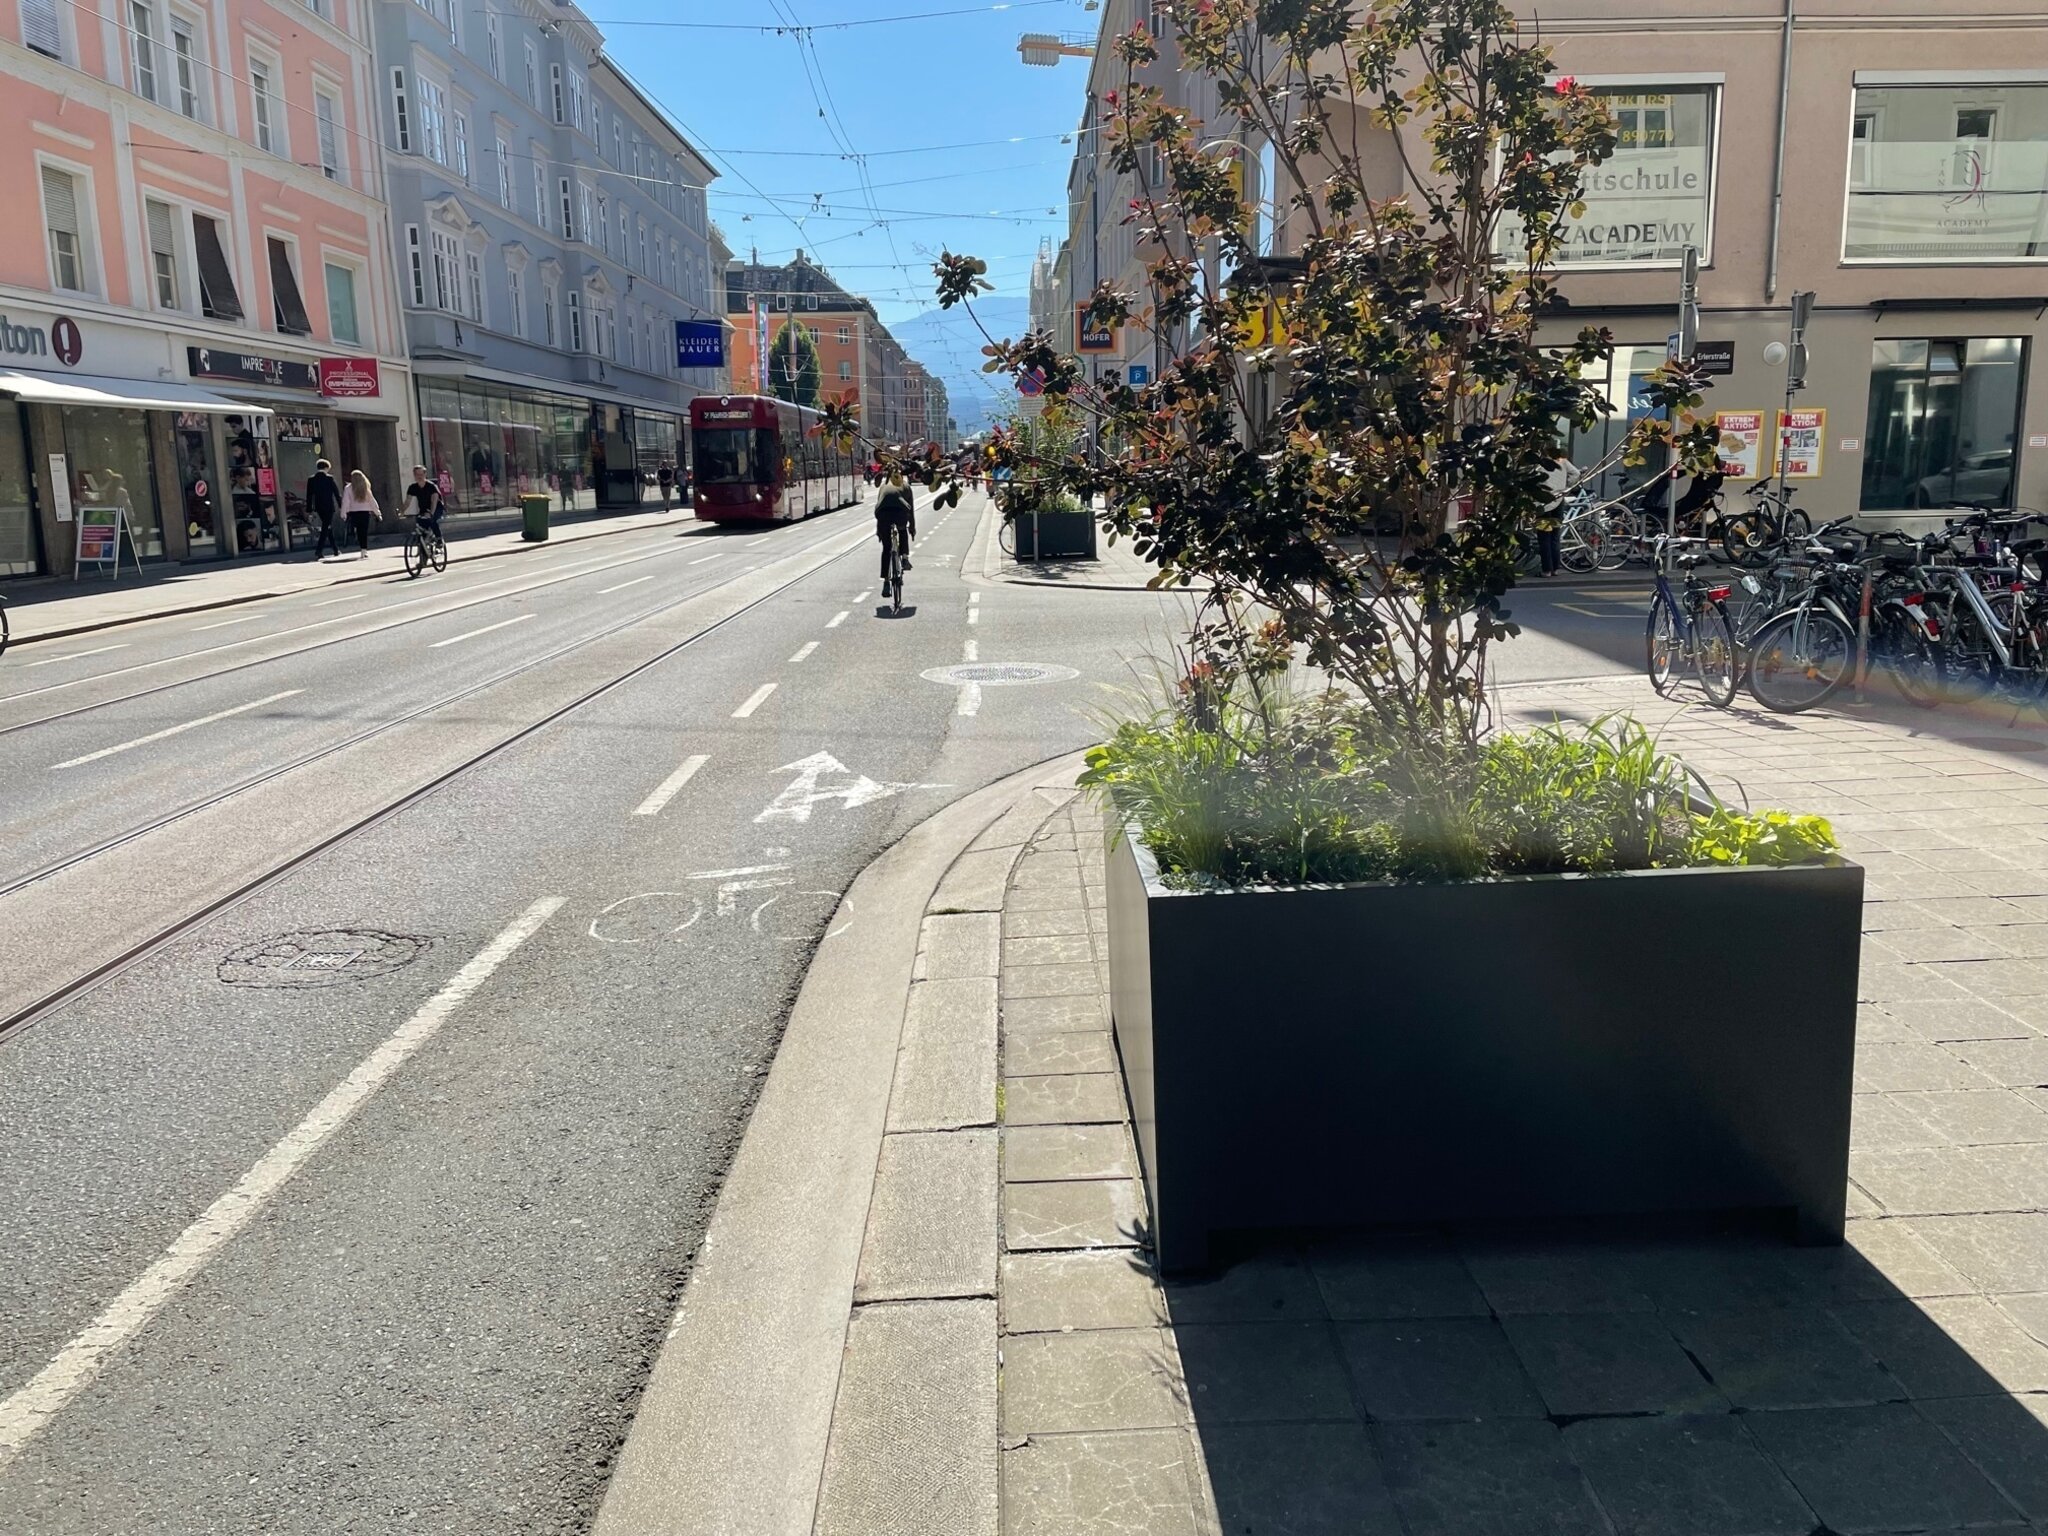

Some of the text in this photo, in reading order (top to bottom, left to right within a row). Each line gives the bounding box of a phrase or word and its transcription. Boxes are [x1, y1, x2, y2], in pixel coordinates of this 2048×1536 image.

[1580, 166, 1698, 192] ttschule
[1936, 219, 1991, 228] ACADEMY
[1504, 222, 1696, 246] TAZACADEMY
[0, 314, 48, 356] ton
[1083, 333, 1111, 341] HOFER
[679, 337, 720, 346] KLEIDER
[680, 345, 720, 353] BAUER
[1696, 352, 1731, 361] Erlerstraße
[1791, 413, 1817, 421] XTREM
[1724, 422, 1755, 430] AKTION
